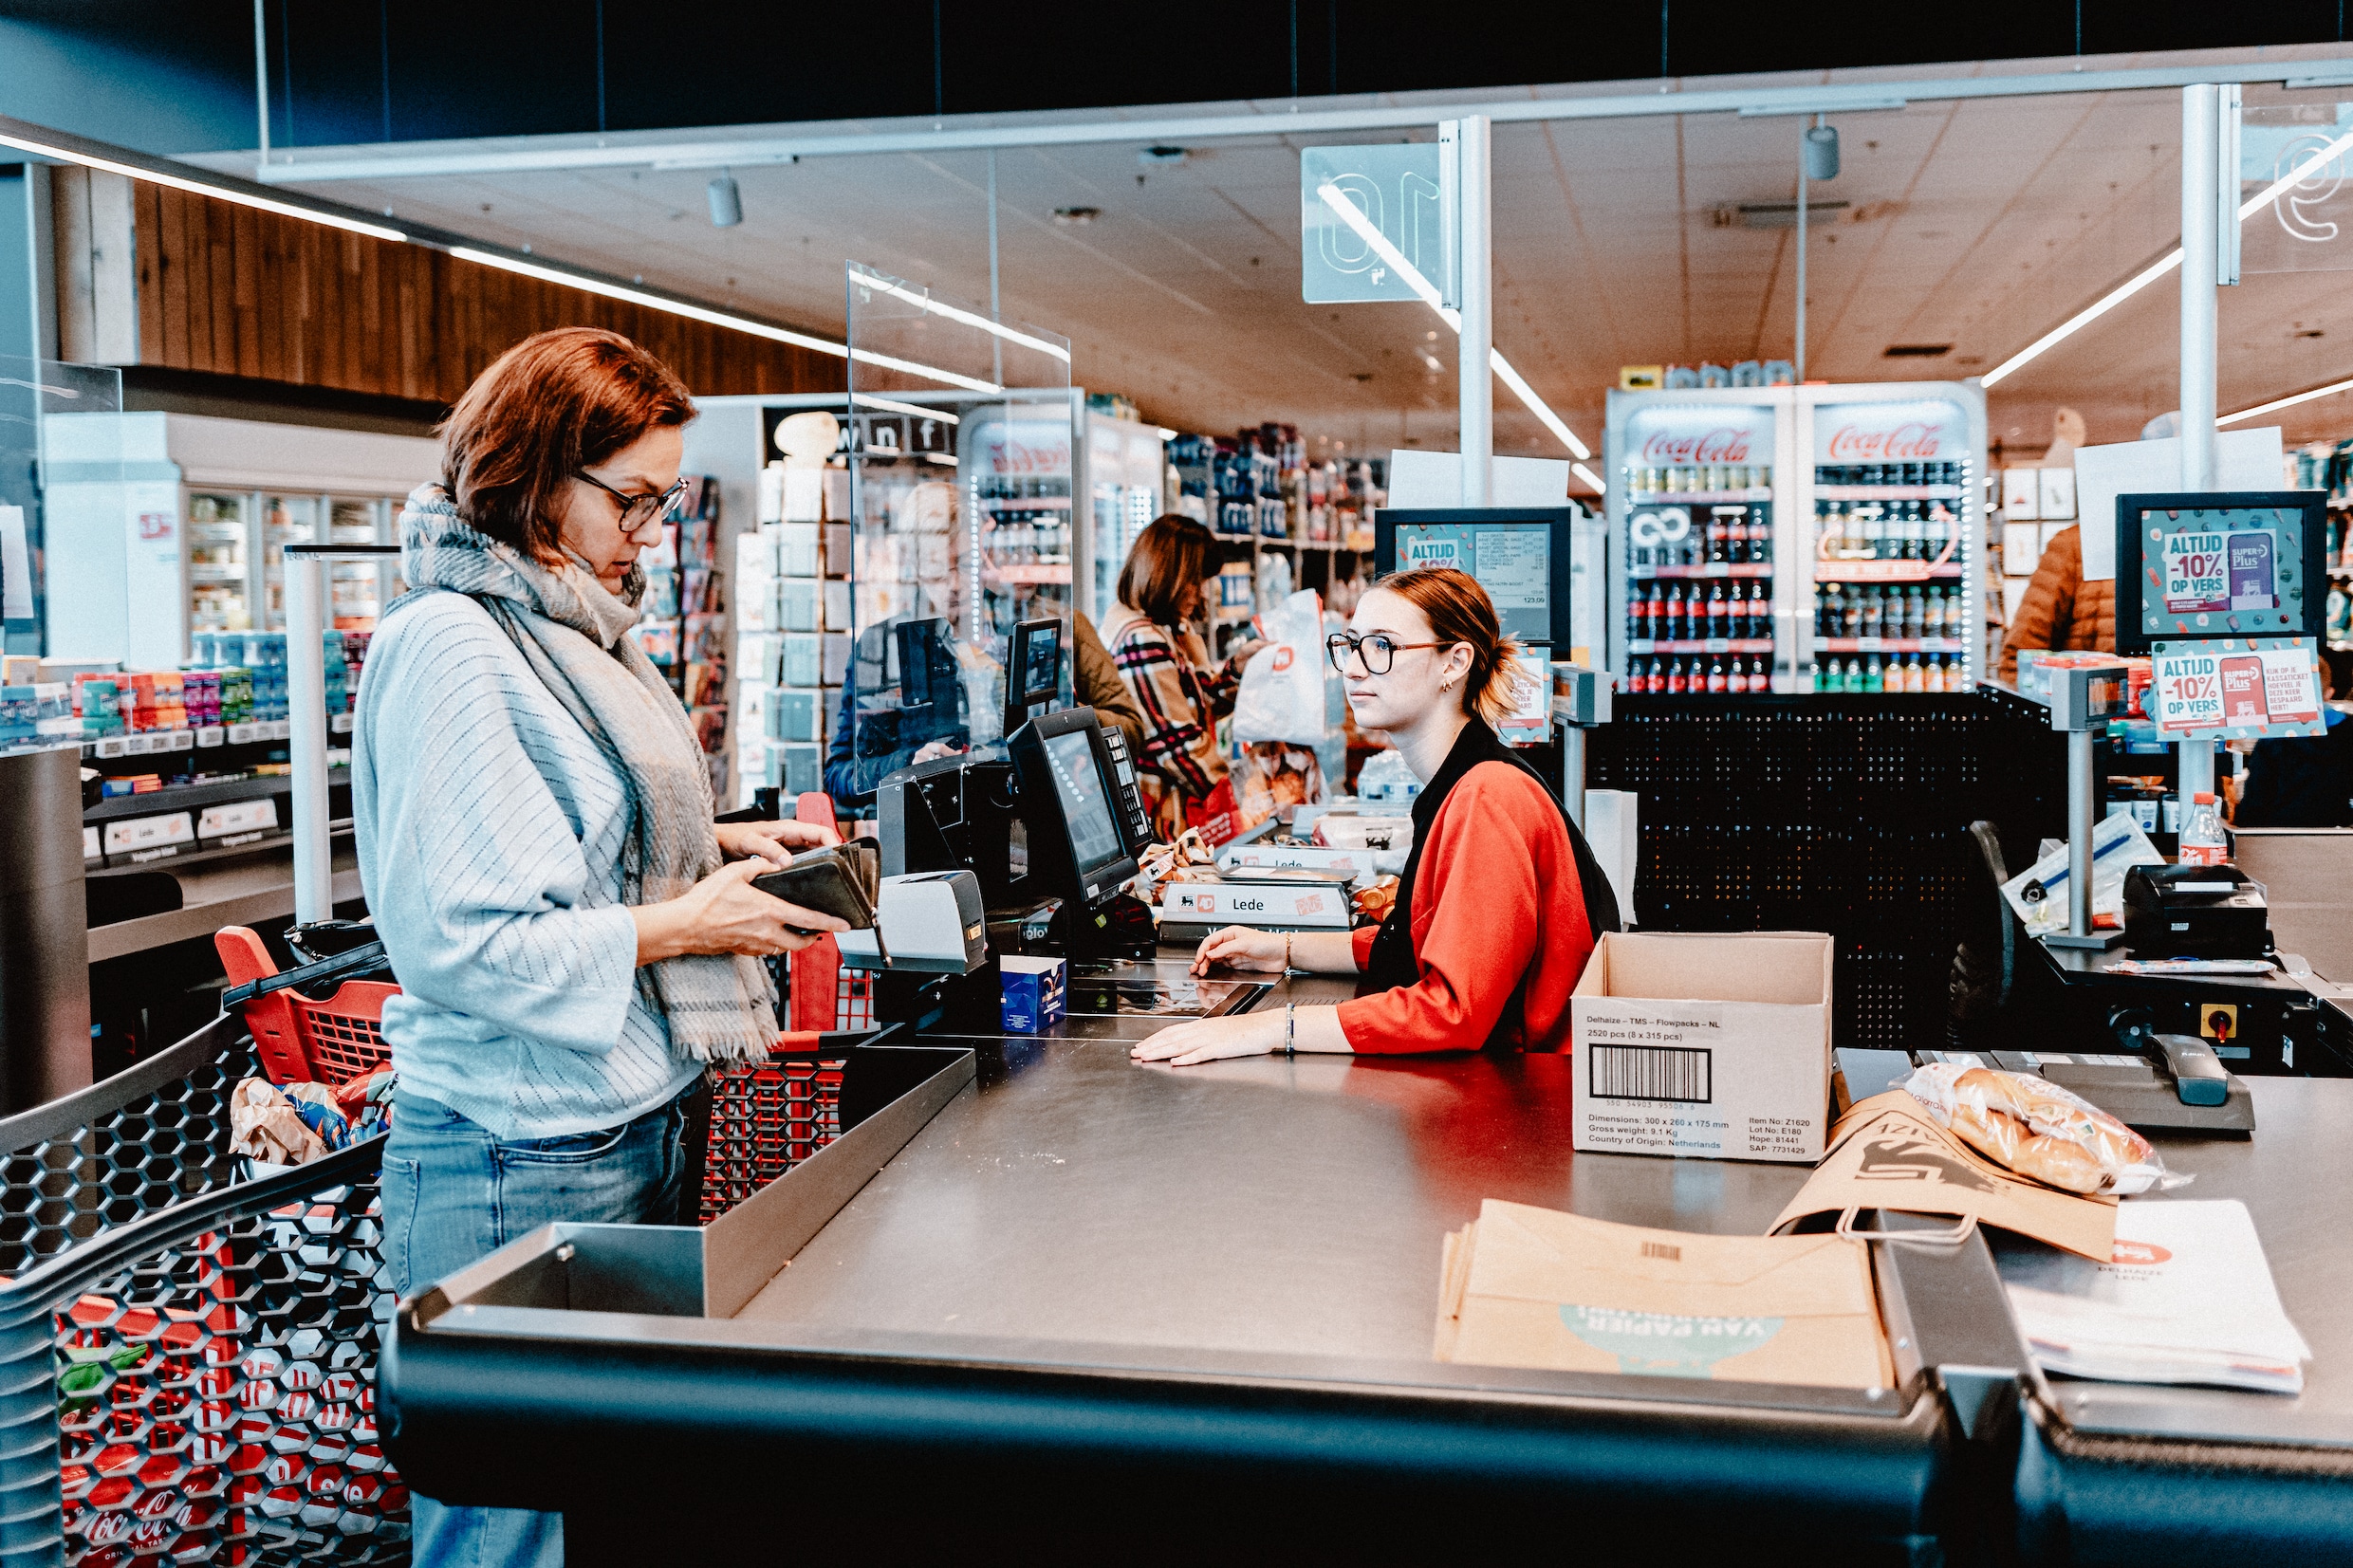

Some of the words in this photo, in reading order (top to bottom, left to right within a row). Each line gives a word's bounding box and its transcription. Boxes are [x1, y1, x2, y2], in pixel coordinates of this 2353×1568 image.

[2170, 535, 2223, 554] ALTIJD
[1413, 544, 1454, 559] ALTIJD
[2171, 554, 2223, 578] -10%
[2233, 556, 2257, 567] Plus
[2172, 580, 2188, 593] OP
[2192, 578, 2223, 592] VERS
[2164, 658, 2214, 677] ALTIJD
[2165, 676, 2216, 700] -10%
[2225, 677, 2251, 689] Plus
[2168, 702, 2184, 713] OP
[2188, 699, 2218, 712] VERS
[1233, 898, 1264, 911] Lede
[1586, 1016, 1621, 1024] Delhaize
[1629, 1017, 1647, 1025] TMS
[1657, 1019, 1699, 1027] Flowpacks
[1628, 1030, 1637, 1040] (8
[1663, 1033, 1683, 1042] pcs)
[1588, 1115, 1642, 1124] Dimensions:
[1617, 1126, 1648, 1135] weight:
[1666, 1129, 1678, 1137] Kg
[1588, 1134, 1623, 1144] Country
[1637, 1137, 1666, 1147] Origin:
[1668, 1139, 1721, 1149] Netherlands
[1749, 1134, 1773, 1143] Hope:
